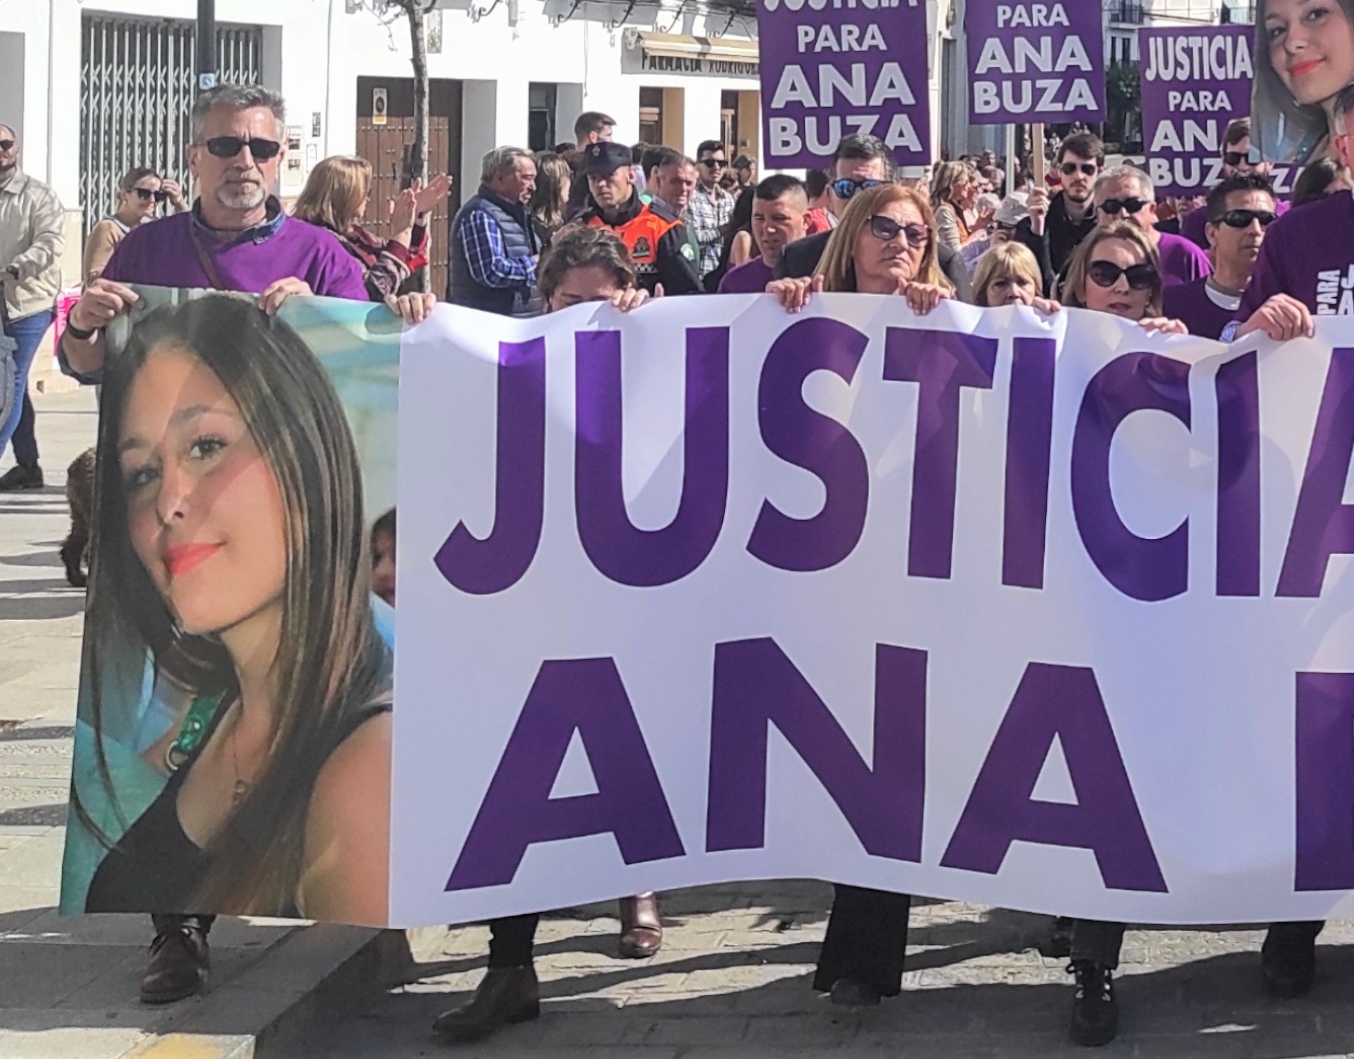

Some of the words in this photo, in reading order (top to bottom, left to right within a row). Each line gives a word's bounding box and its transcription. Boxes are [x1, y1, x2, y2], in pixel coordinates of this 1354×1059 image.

[996, 3, 1071, 29] PARA
[797, 23, 888, 53] PARA
[974, 34, 1094, 75] ANA
[1144, 34, 1254, 82] JUSTICIA
[770, 62, 916, 109] ANA
[973, 78, 1099, 114] BUZA
[1168, 90, 1232, 112] PARA
[1150, 119, 1219, 152] AN
[1149, 157, 1225, 188] BUZ
[1316, 269, 1341, 316] PARA
[445, 636, 1168, 894] ANA
